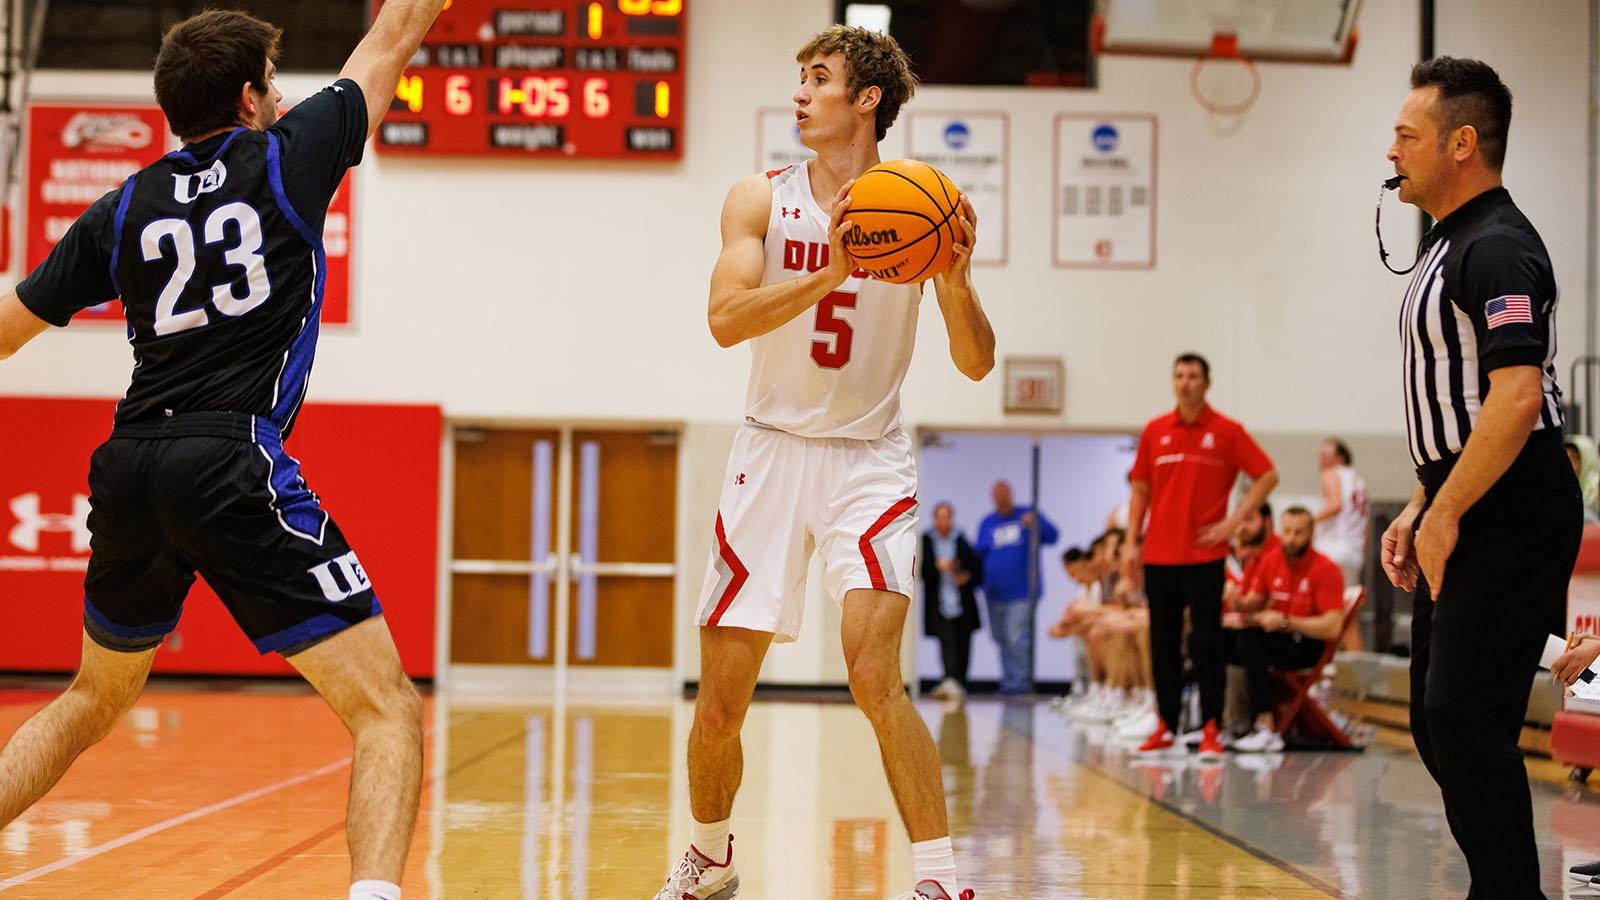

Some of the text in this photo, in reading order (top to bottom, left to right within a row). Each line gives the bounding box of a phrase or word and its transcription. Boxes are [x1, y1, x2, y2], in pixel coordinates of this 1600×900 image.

[445, 74, 473, 116] 6
[583, 76, 610, 118] 6
[655, 80, 670, 118] 1
[843, 223, 900, 247] ilson
[140, 201, 272, 337] 23
[809, 289, 859, 371] 5
